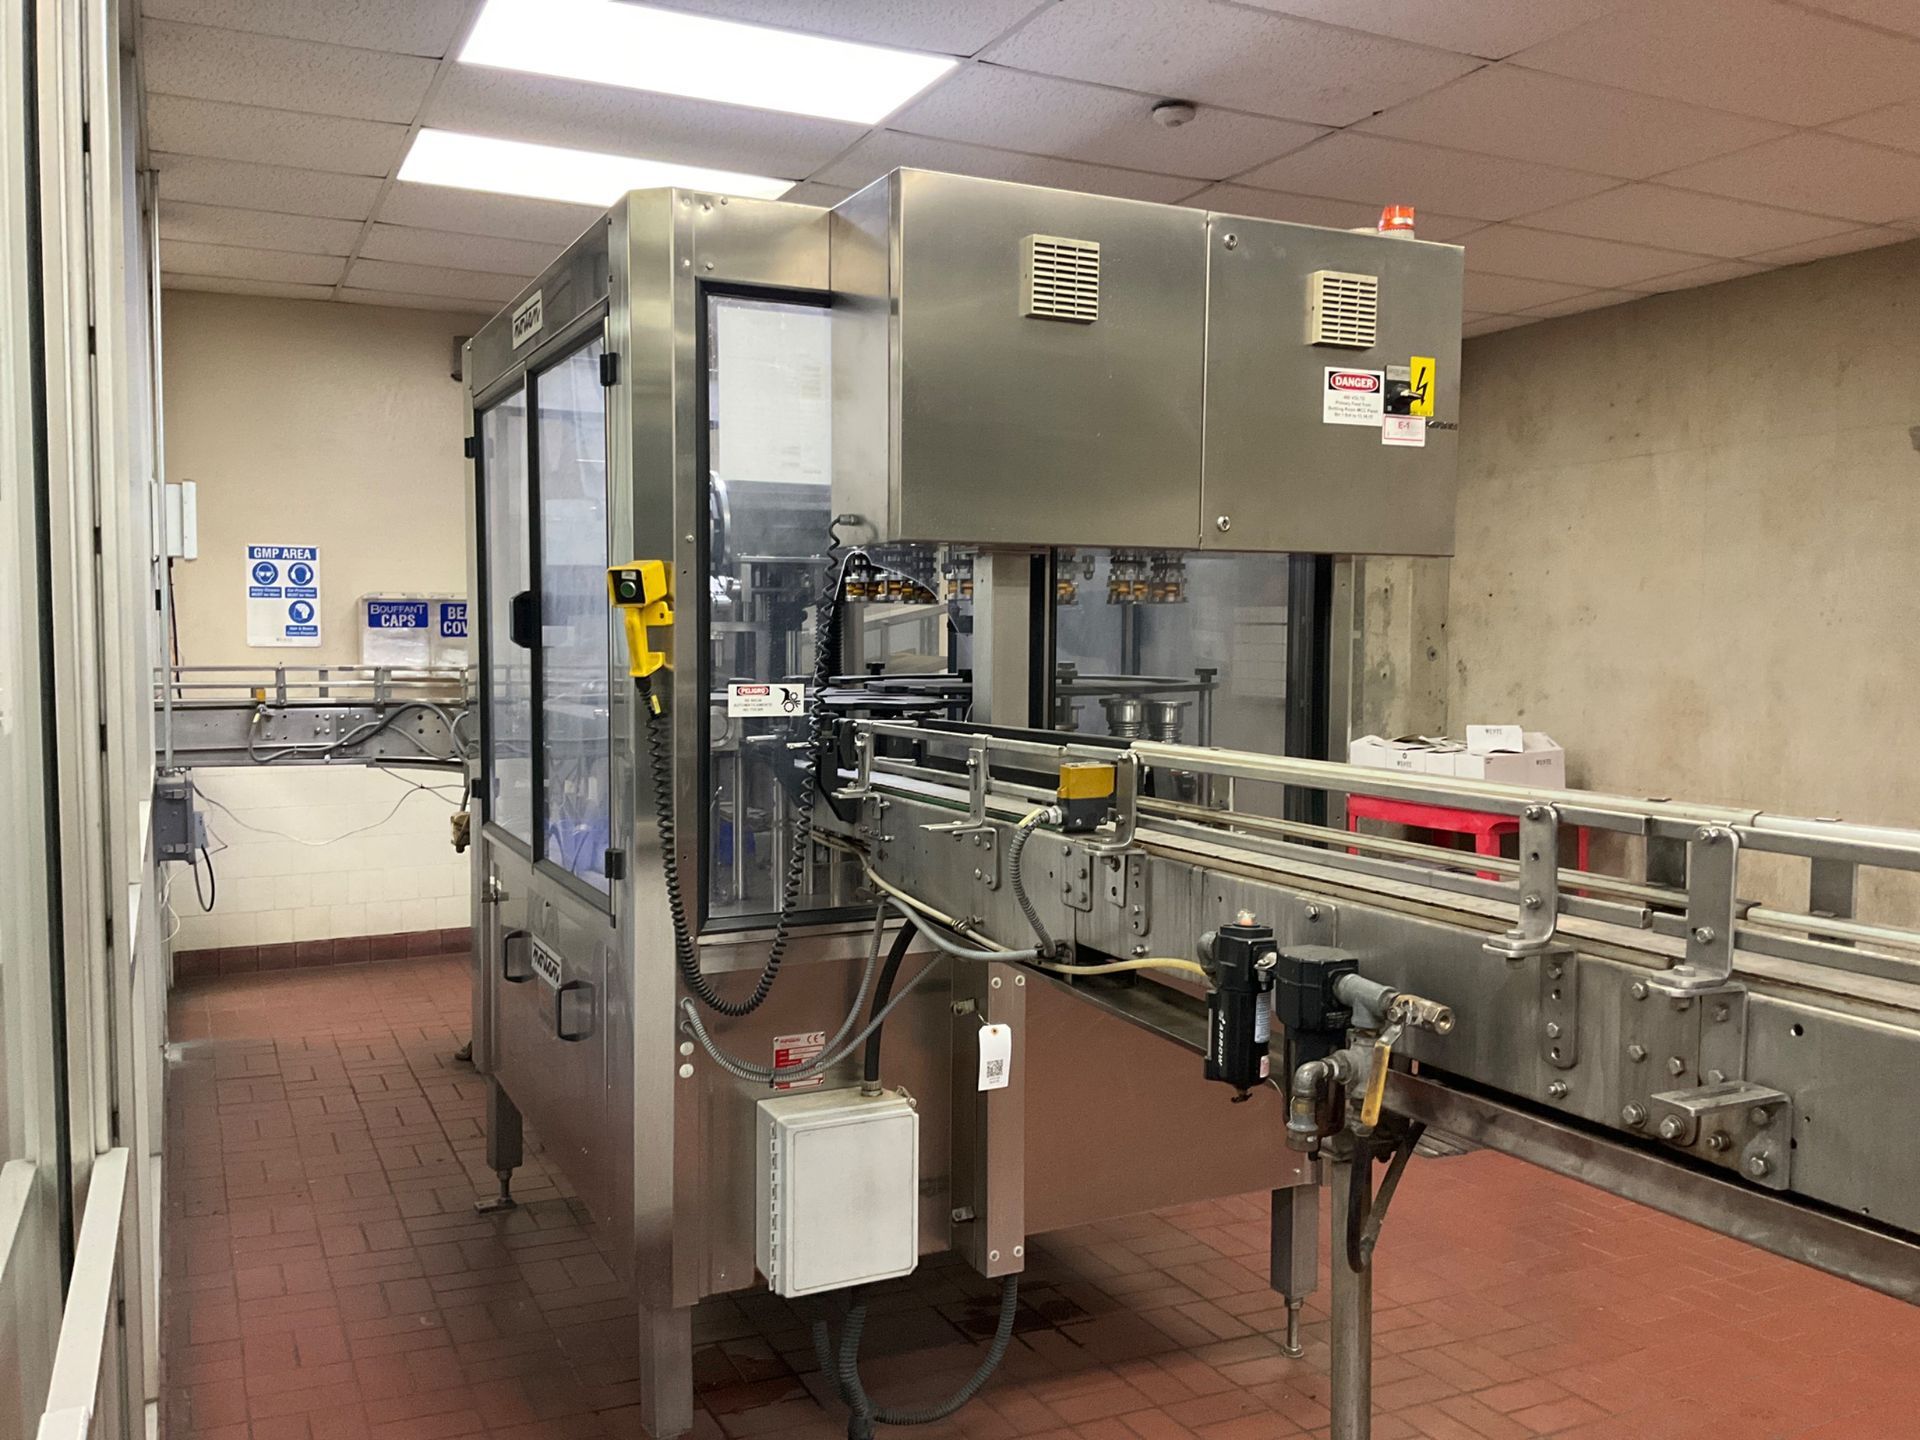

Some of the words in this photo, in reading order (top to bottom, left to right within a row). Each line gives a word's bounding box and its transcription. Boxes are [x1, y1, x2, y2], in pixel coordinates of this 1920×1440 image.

[1335, 376, 1374, 389] DANGER
[253, 547, 280, 559] GMP
[282, 548, 311, 560] AREA
[371, 604, 425, 615] BOUFFANT
[381, 614, 416, 627] CAPS
